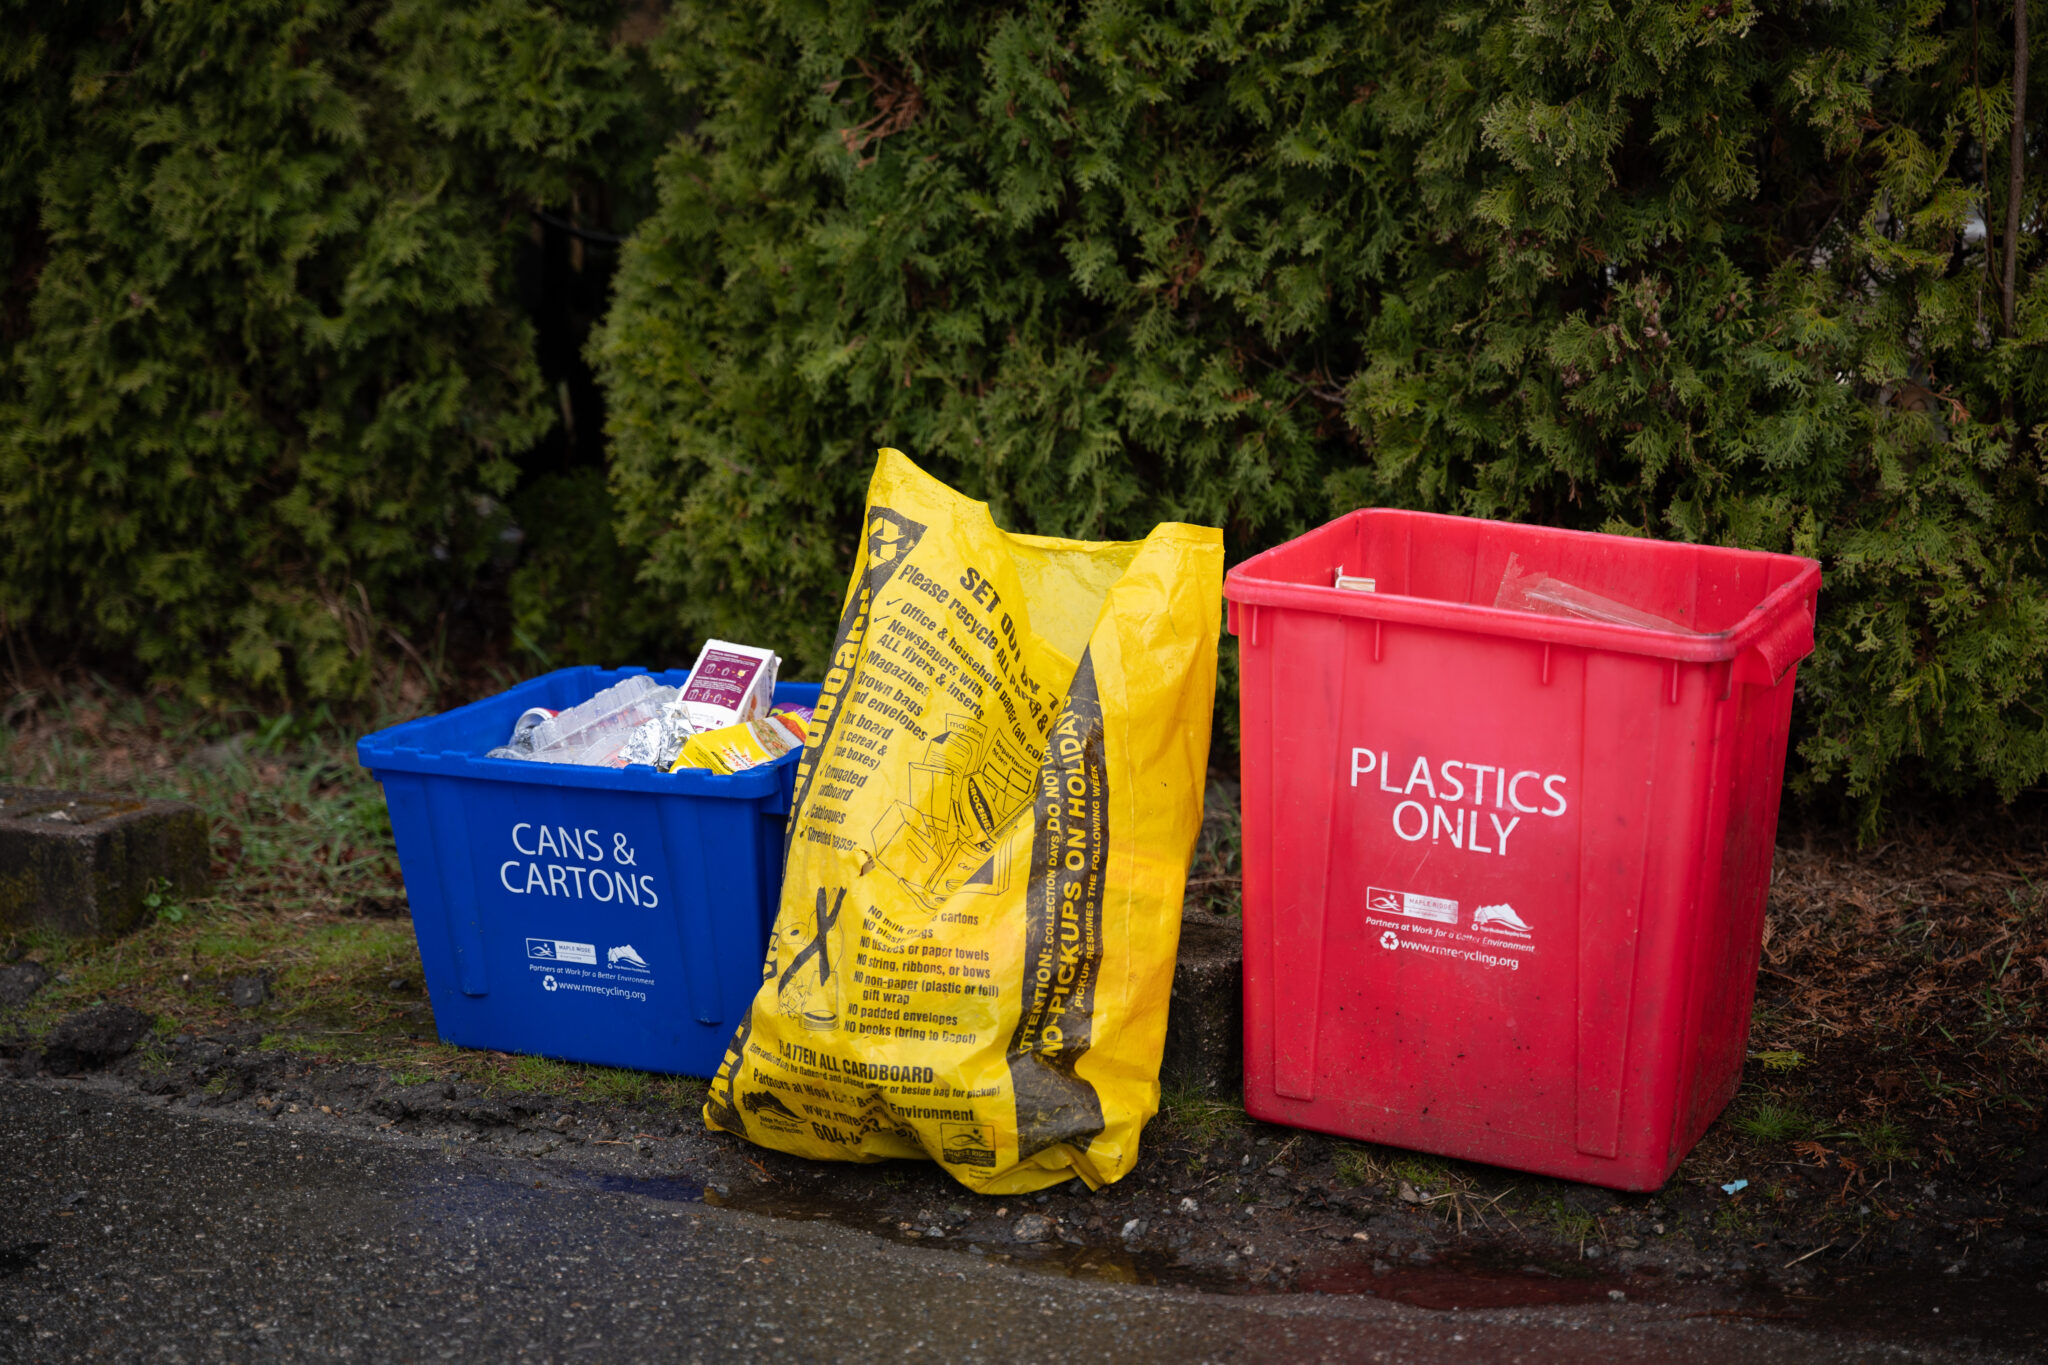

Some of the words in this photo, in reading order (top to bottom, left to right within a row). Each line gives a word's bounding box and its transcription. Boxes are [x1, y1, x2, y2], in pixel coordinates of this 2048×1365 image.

[960, 567, 1002, 614] SET
[888, 619, 959, 676] Newspapers
[959, 672, 984, 698] with
[898, 564, 949, 604] Please
[948, 598, 999, 650] recycle
[996, 648, 1010, 678] ALL
[1037, 714, 1048, 734] &
[866, 650, 930, 697] Magazines
[877, 634, 900, 653] ALL
[901, 646, 936, 676] flyers
[935, 673, 946, 686] &
[946, 682, 984, 720] inserts
[900, 602, 936, 632] Office
[937, 628, 948, 641] &
[948, 637, 1002, 693] household
[999, 691, 1017, 725] paper
[1013, 722, 1027, 746] (all
[893, 689, 924, 717] bags
[856, 714, 894, 740] board
[868, 698, 928, 741] envelopes
[847, 731, 878, 751] cereal
[877, 745, 888, 756] &
[847, 746, 880, 770] boxes)
[992, 748, 1008, 766] Store
[996, 739, 1032, 776] Department
[1042, 769, 1060, 798] NOT
[1090, 765, 1100, 798] WEEK
[1350, 747, 1568, 816] PLASTICS
[1047, 804, 1061, 832] DO
[1392, 800, 1520, 856] ONLY
[512, 822, 604, 862] CANS
[613, 832, 638, 866] &
[1048, 835, 1060, 866] DAYS
[1065, 828, 1086, 872] ON
[1092, 801, 1102, 872] FOLLOWING
[500, 860, 659, 908] CARTONS
[1088, 874, 1096, 898] THE
[868, 905, 882, 920] NO
[882, 918, 905, 934] milk
[941, 912, 979, 926] cartons
[1045, 869, 1056, 944] COLLECTION
[862, 918, 876, 932] NO
[1086, 902, 1095, 960] RESUMES
[1366, 916, 1400, 930] Partners
[1401, 923, 1410, 932] at
[1412, 924, 1434, 936] Work
[1434, 927, 1446, 938] for
[1482, 936, 1536, 953] Environment
[860, 936, 870, 948] NO
[908, 945, 919, 954] or
[922, 946, 952, 958] paper
[955, 948, 990, 962] towels
[1048, 882, 1082, 1014] PICKUPS
[1400, 940, 1520, 970] www.rmrecycling.org
[530, 964, 556, 974] Partners
[565, 968, 581, 976] Work
[582, 970, 591, 978] for
[598, 972, 616, 980] Better
[617, 974, 656, 986] Environment
[856, 953, 867, 966] NO
[868, 957, 899, 972] string,
[902, 961, 946, 976] ribbons,
[948, 966, 960, 976] or
[963, 966, 990, 979] bows
[558, 982, 646, 1002] www.rmrecycling.org
[854, 970, 864, 984] NO
[864, 975, 918, 992] non-paper
[921, 980, 962, 994] (plastic
[964, 986, 976, 995] or
[978, 984, 1000, 998] foil)
[862, 990, 880, 1002] gift
[884, 992, 910, 1006] wrap
[1074, 962, 1090, 1008] PICKUP
[848, 1003, 858, 1016] NO
[860, 1007, 900, 1022] padded
[903, 1011, 958, 1026] envelopes
[844, 1020, 856, 1033] NO
[859, 1023, 891, 1036] books
[894, 1027, 926, 1042] (bring
[929, 1030, 939, 1041] to
[1041, 1025, 1064, 1057] NO
[754, 1068, 791, 1092] Partners
[790, 1063, 798, 1073] be
[829, 1073, 842, 1083] and
[890, 1085, 900, 1094] or
[902, 1085, 932, 1096] beside
[934, 1087, 950, 1098] bag
[952, 1088, 966, 1098] for
[967, 1086, 1000, 1100] pickup)
[820, 1054, 840, 1072] ALL
[842, 1060, 934, 1084] CARDBOARD
[890, 1102, 974, 1122] Environment
